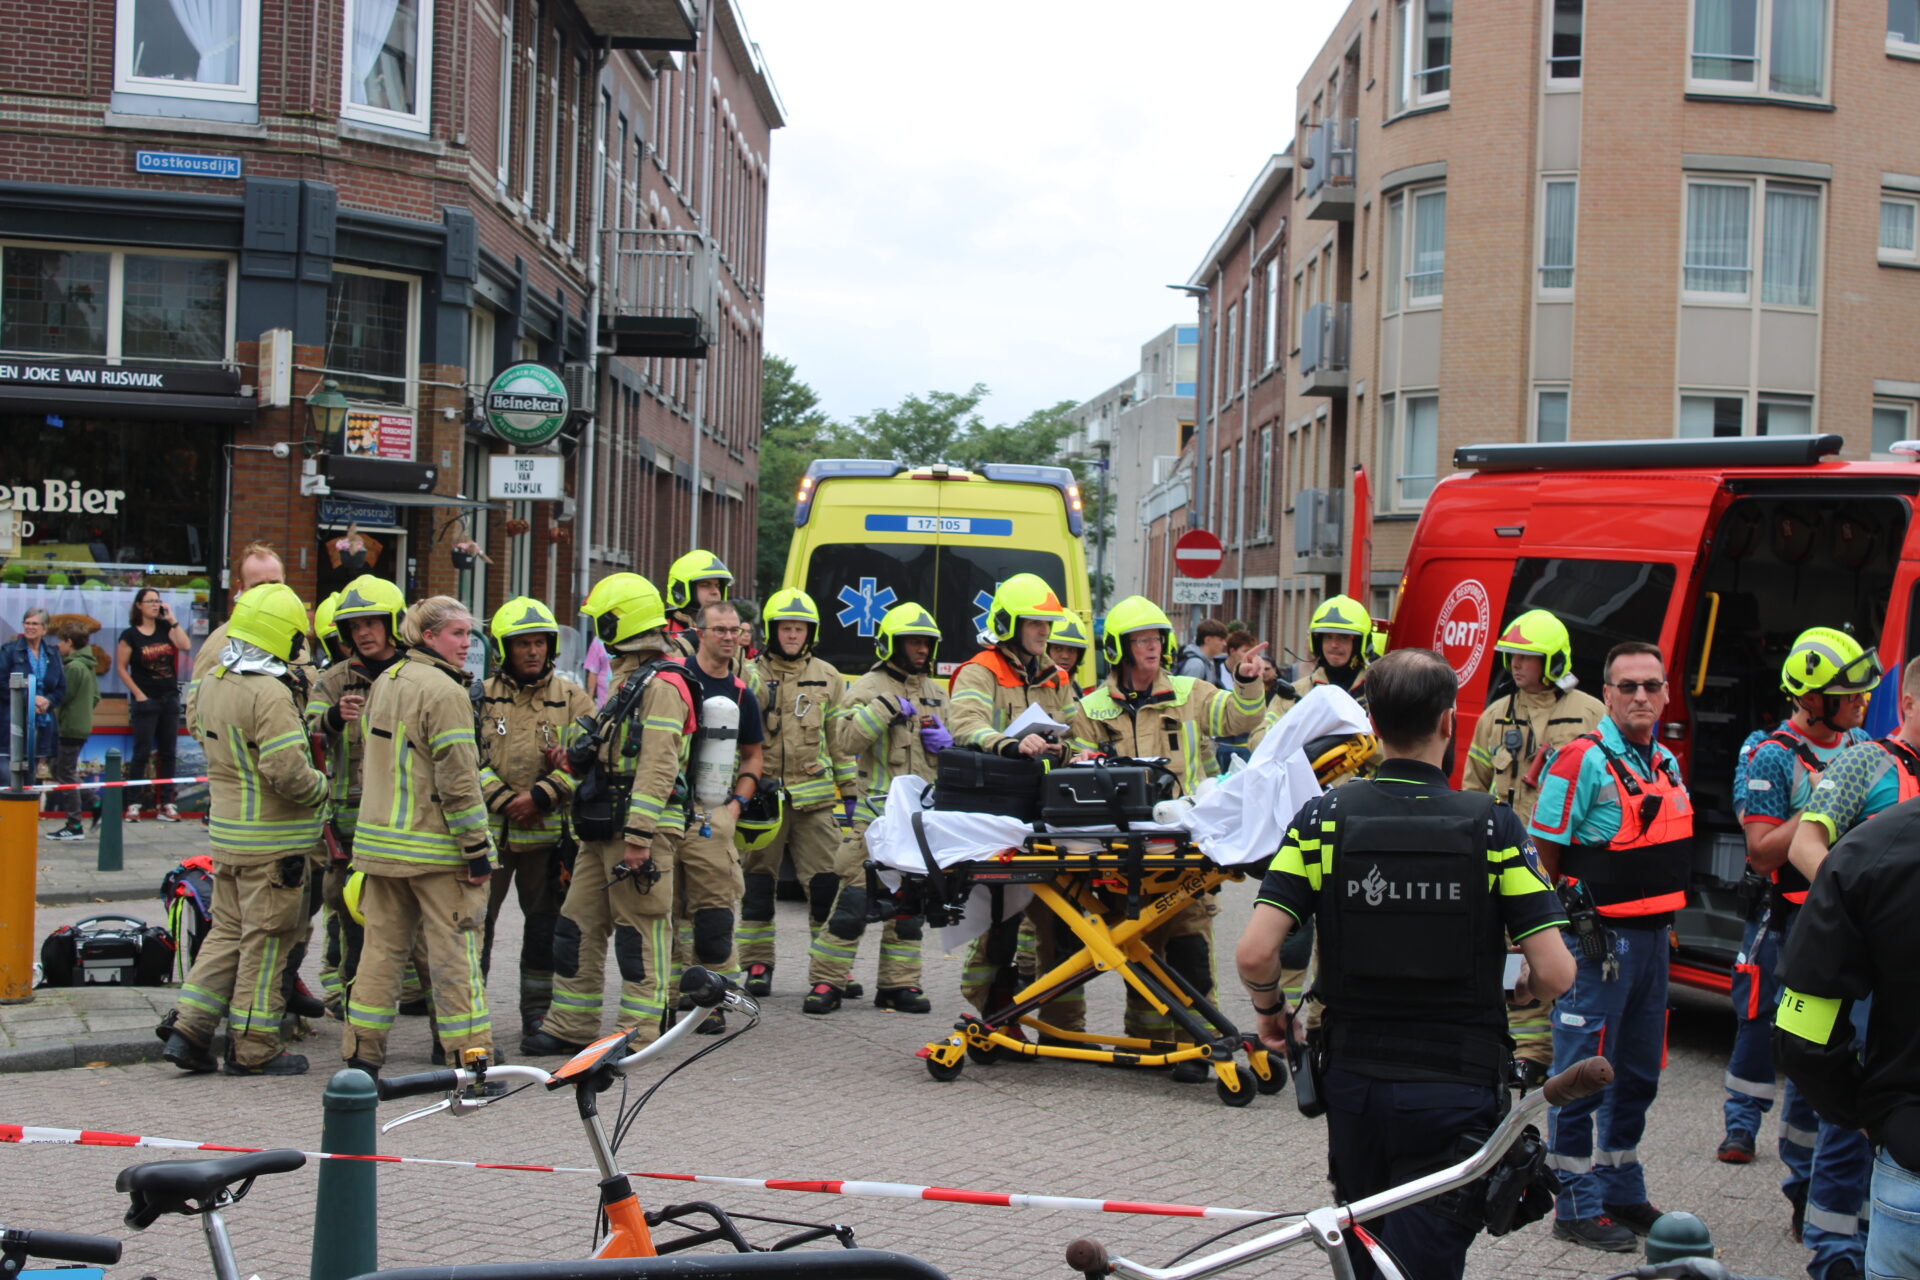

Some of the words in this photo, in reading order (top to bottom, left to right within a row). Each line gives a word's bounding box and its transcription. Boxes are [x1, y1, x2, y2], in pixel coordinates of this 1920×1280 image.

[142, 155, 235, 174] Oostkousdijk
[0, 365, 19, 379] EN
[22, 367, 60, 382] JOKE
[65, 369, 96, 383] VAN
[101, 371, 164, 387] RIJSWIJK
[493, 395, 560, 412] Heineken
[514, 459, 535, 472] THEO
[518, 473, 531, 481] VAN
[42, 479, 126, 515] Bier
[504, 482, 543, 494] RIJSWIJK
[917, 519, 961, 531] 17-105
[1440, 597, 1456, 626] QUICK
[1456, 584, 1484, 604] RESPONSE
[1480, 601, 1488, 631] TEAM
[1444, 620, 1479, 647] QRT
